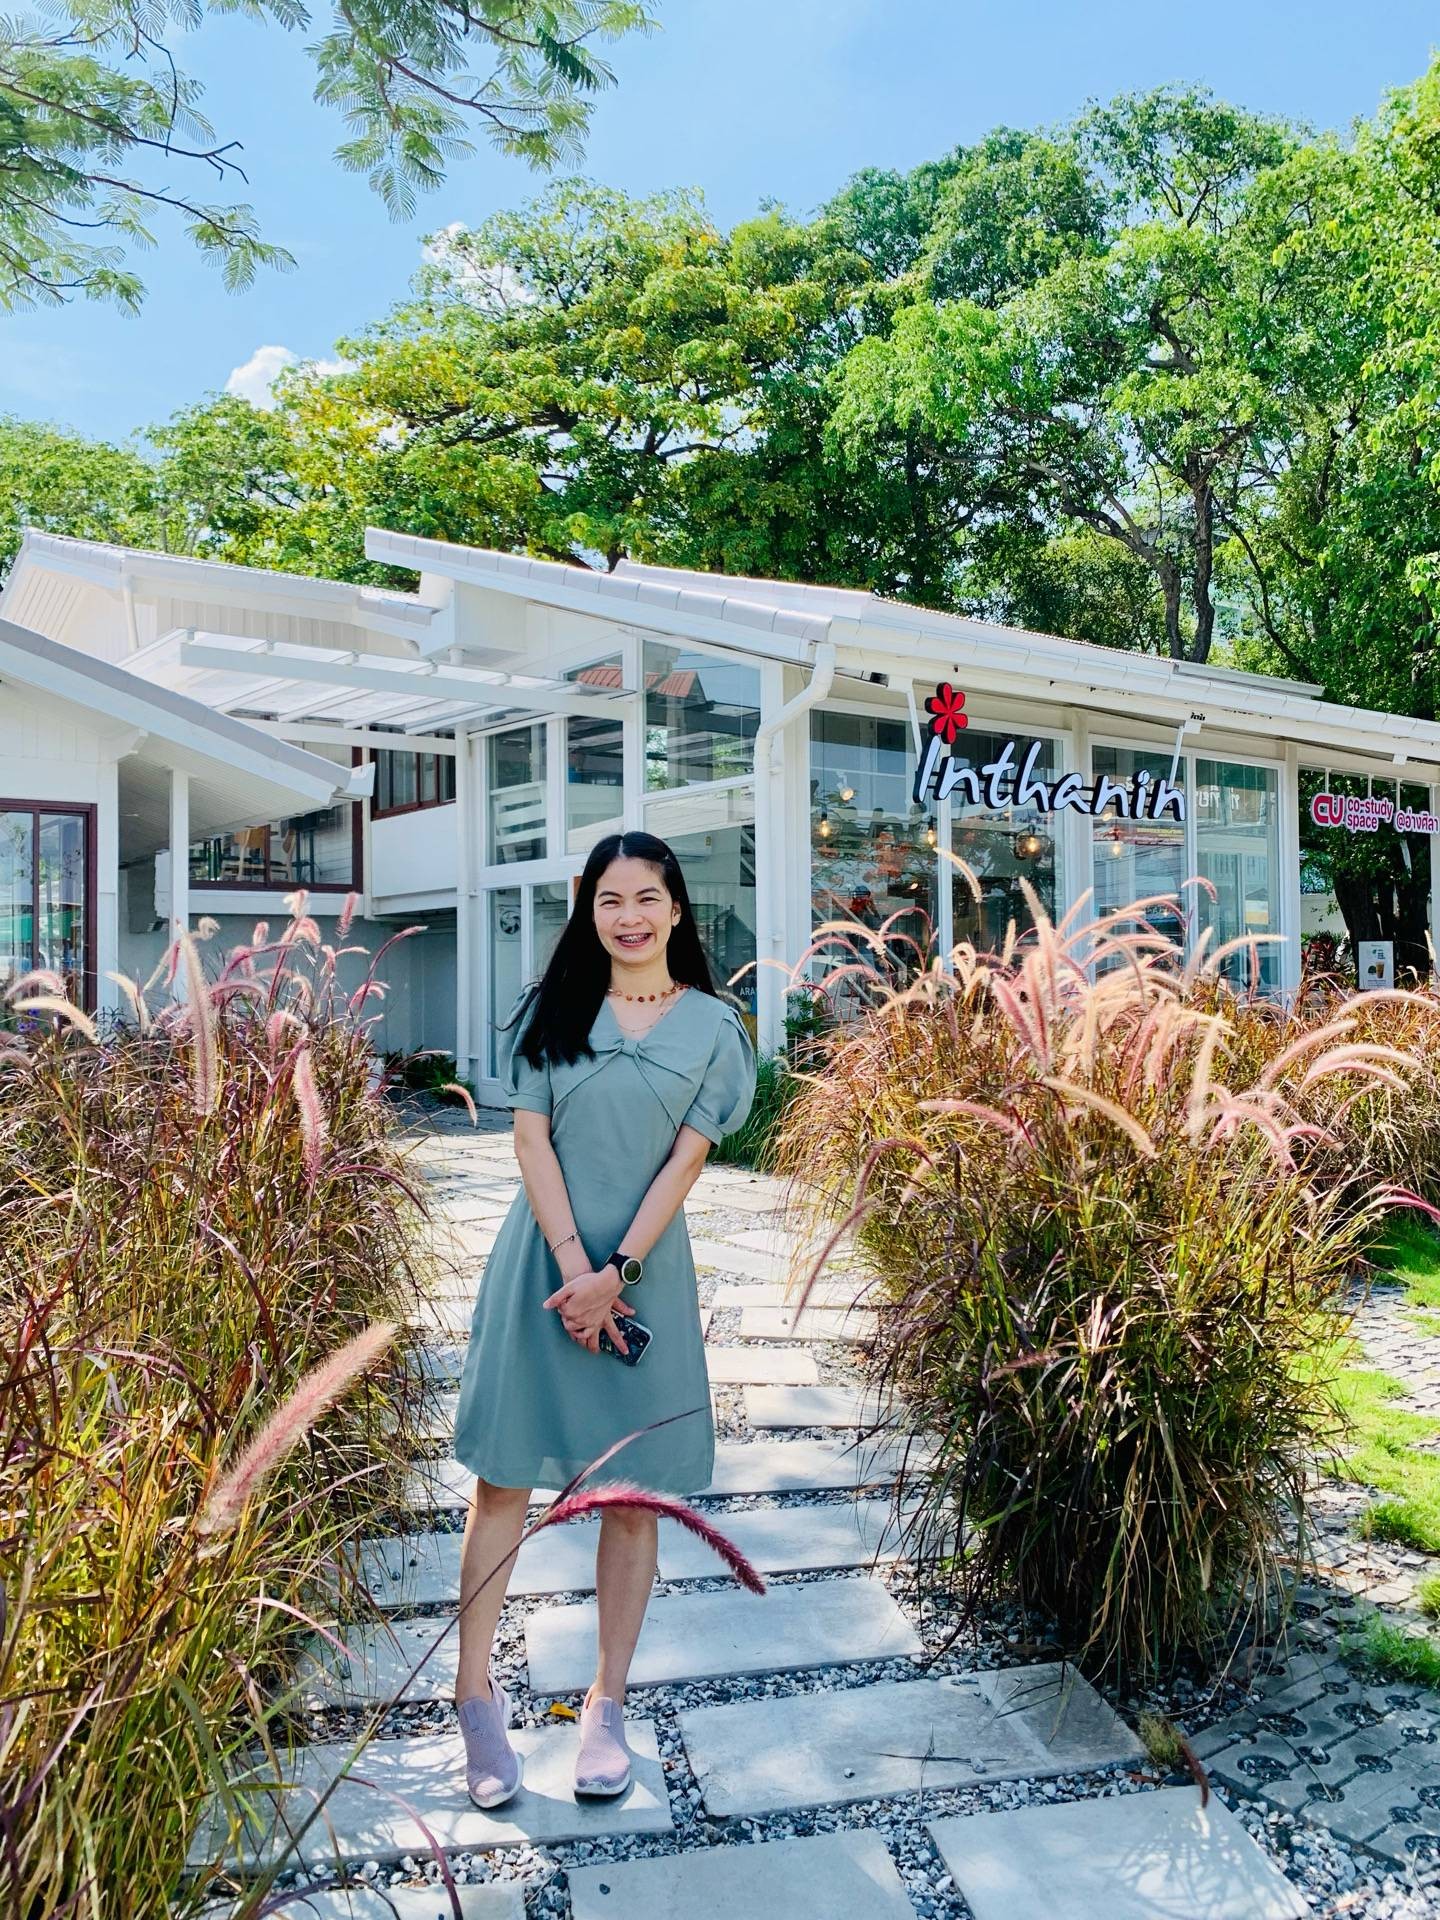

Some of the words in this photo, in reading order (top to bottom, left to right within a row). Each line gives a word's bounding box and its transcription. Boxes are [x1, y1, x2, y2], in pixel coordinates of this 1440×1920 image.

[914, 735, 1185, 821] Inthanin
[1313, 795, 1344, 825] CU
[1347, 798, 1392, 820] co-study
[1347, 814, 1378, 830] space
[740, 986, 757, 996] ARA
